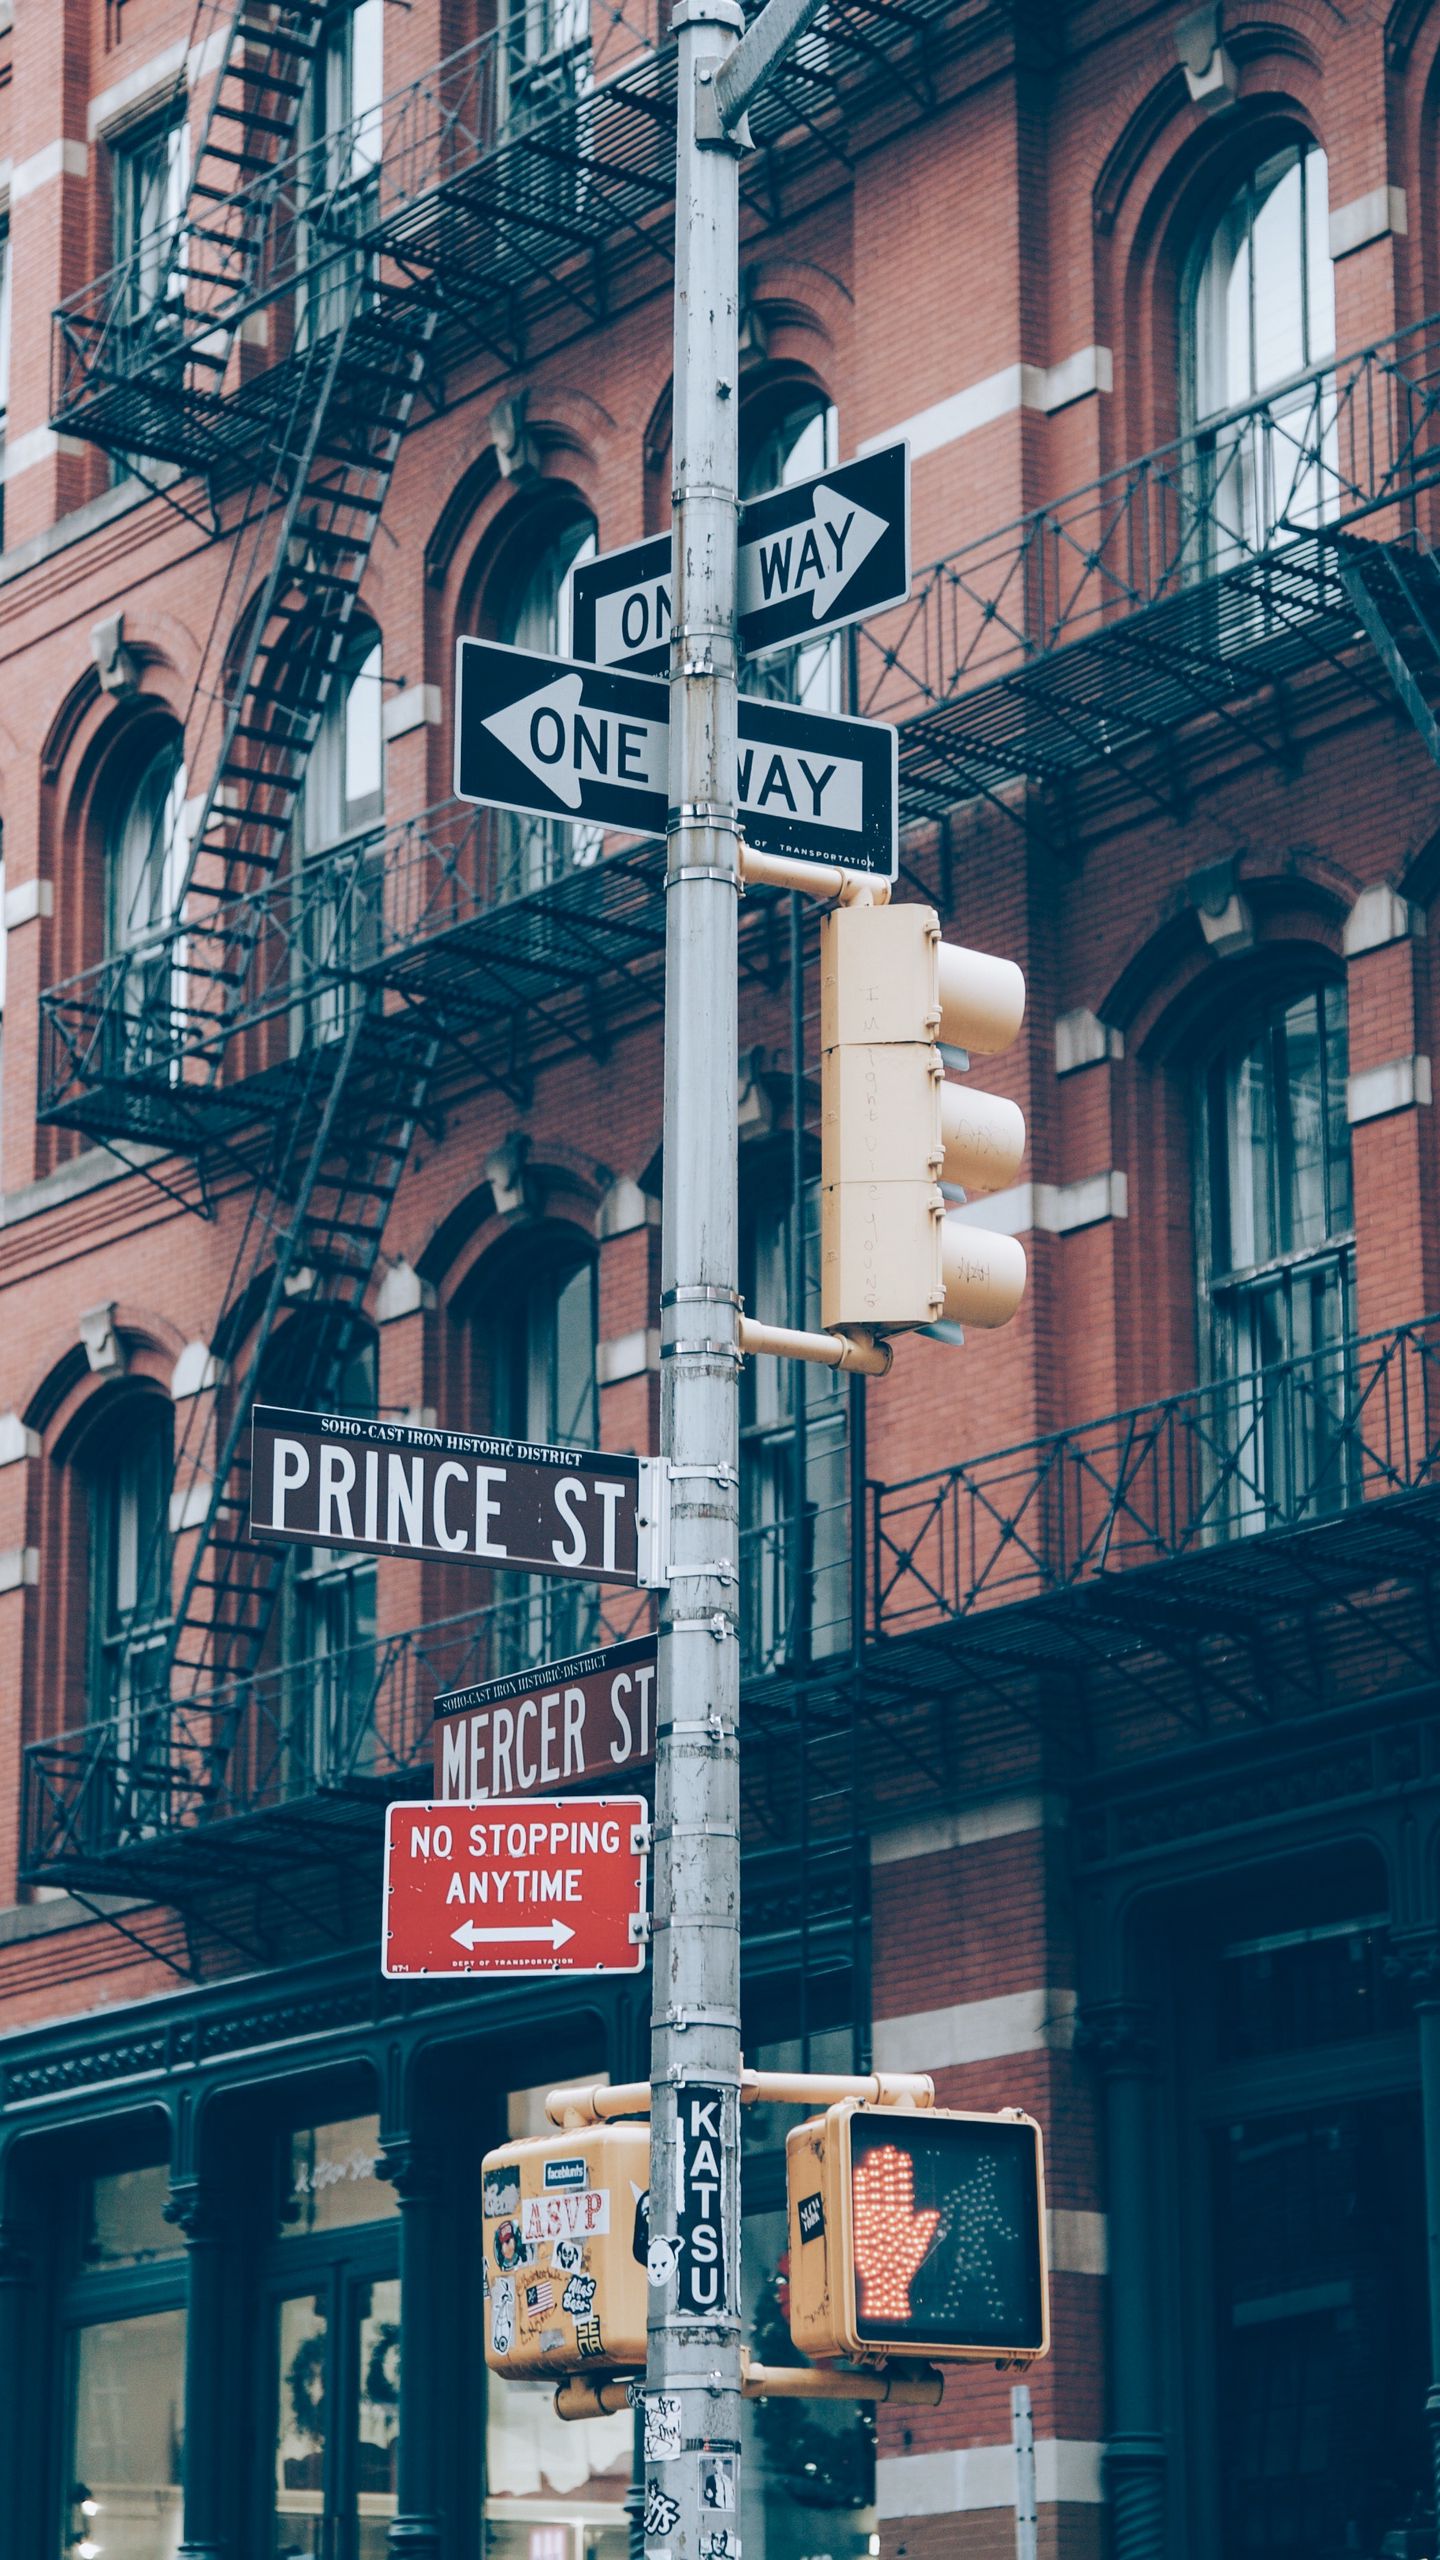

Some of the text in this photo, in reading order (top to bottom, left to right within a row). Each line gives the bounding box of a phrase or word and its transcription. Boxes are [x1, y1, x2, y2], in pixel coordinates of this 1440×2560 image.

[622, 511, 856, 648] ON WAY
[529, 706, 649, 784] ONE
[754, 839, 876, 868] OF TRANSPORTATION
[407, 1430, 444, 1448] IRON
[447, 1437, 515, 1458] HISTORIC
[517, 1445, 582, 1467] DISTRICT
[272, 1437, 626, 1572] PRINCE ST
[493, 1685, 516, 1699] IRON
[518, 1670, 564, 1691] HISTORIC
[564, 1654, 607, 1678] DISTRICT
[442, 1665, 655, 1801] MERCER ST
[410, 1820, 620, 1858] NO STOPPING
[446, 1868, 583, 1905] ANYTIME
[495, 1957, 574, 1966] TRANSPORTATION
[525, 2193, 602, 2239] ASVP
[689, 2100, 720, 2304] KATSU
